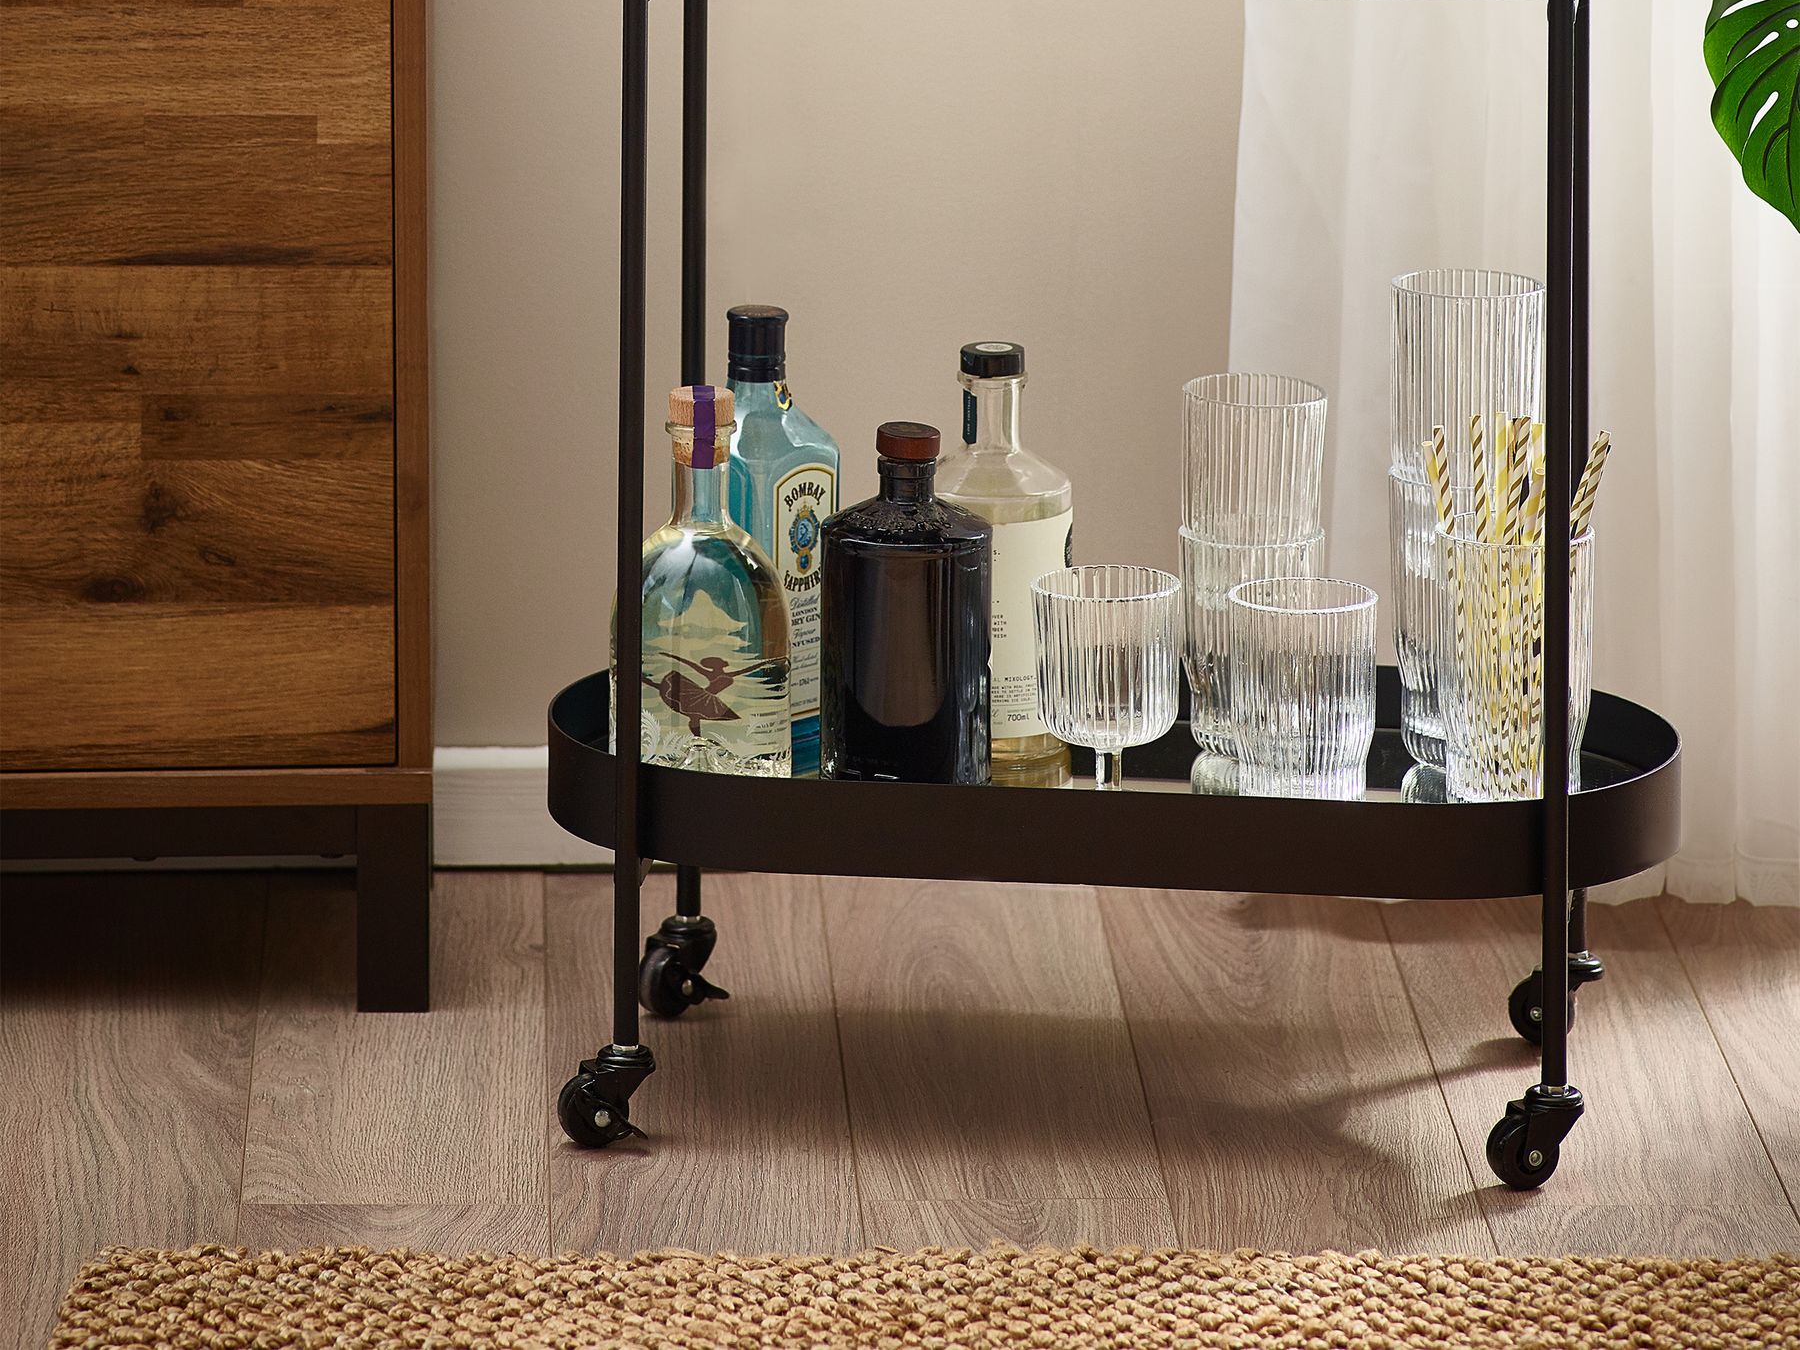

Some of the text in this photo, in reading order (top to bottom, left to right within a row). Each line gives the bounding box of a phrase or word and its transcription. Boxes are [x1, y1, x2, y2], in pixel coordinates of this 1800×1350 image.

[784, 481, 826, 512] BOMBAY
[784, 567, 821, 592] SAPPHIR
[791, 607, 818, 618] LONDON
[805, 613, 821, 623] GIN
[791, 636, 821, 649] NFUSED
[1007, 713, 1029, 721] 700ml
